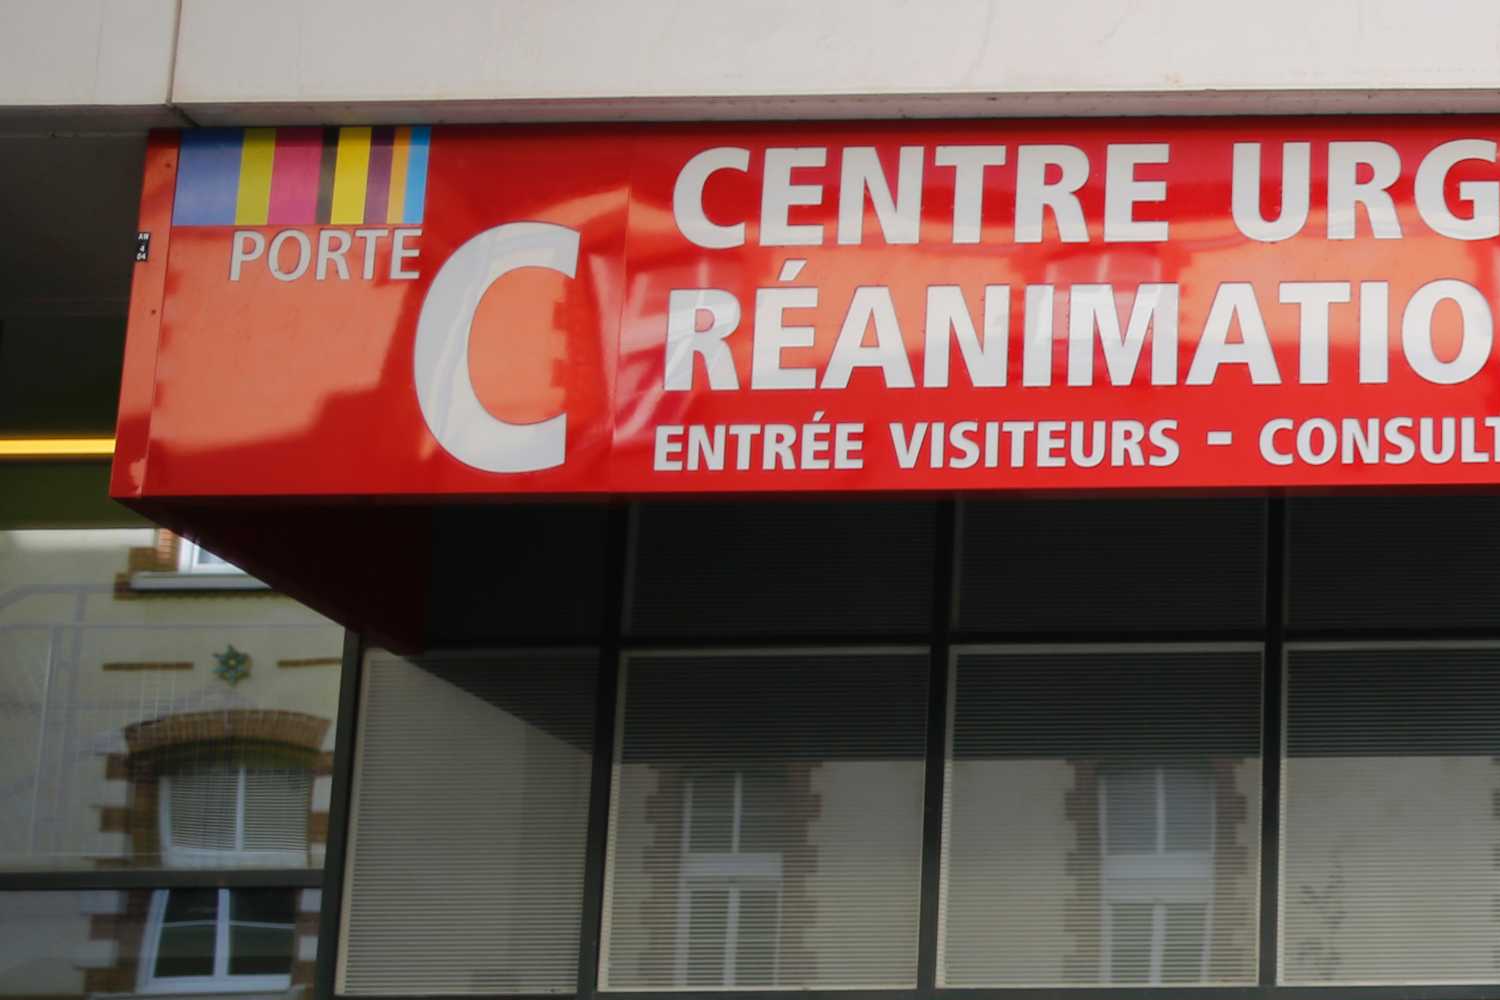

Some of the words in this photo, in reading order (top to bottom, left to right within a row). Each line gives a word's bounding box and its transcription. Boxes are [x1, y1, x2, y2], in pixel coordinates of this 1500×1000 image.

[672, 144, 1170, 249] CENTRE
[228, 229, 422, 282] PORTE
[412, 221, 581, 474] C
[652, 411, 865, 473] ENTRÉE
[888, 418, 1181, 470] VISITEURS
